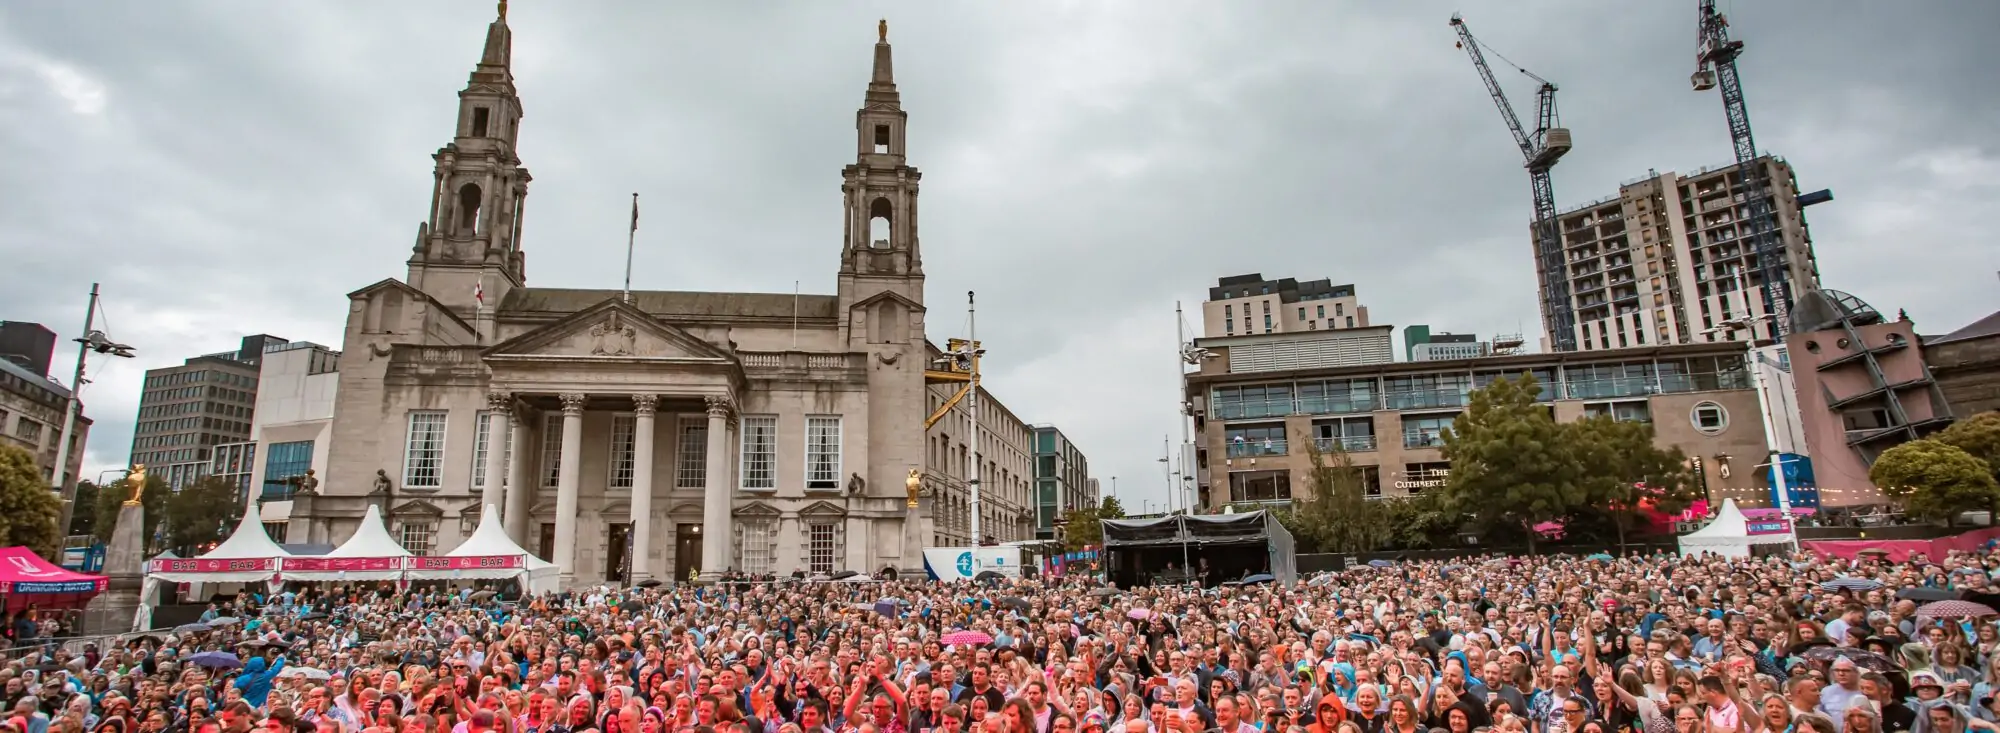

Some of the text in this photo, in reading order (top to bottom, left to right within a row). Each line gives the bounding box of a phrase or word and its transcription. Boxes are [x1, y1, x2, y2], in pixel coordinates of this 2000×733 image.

[172, 561, 197, 570] BAR
[230, 561, 254, 569] BAR
[426, 559, 449, 567] BAR
[481, 558, 504, 566] BAR
[18, 582, 61, 592] DRINKING
[64, 582, 92, 591] WATER
